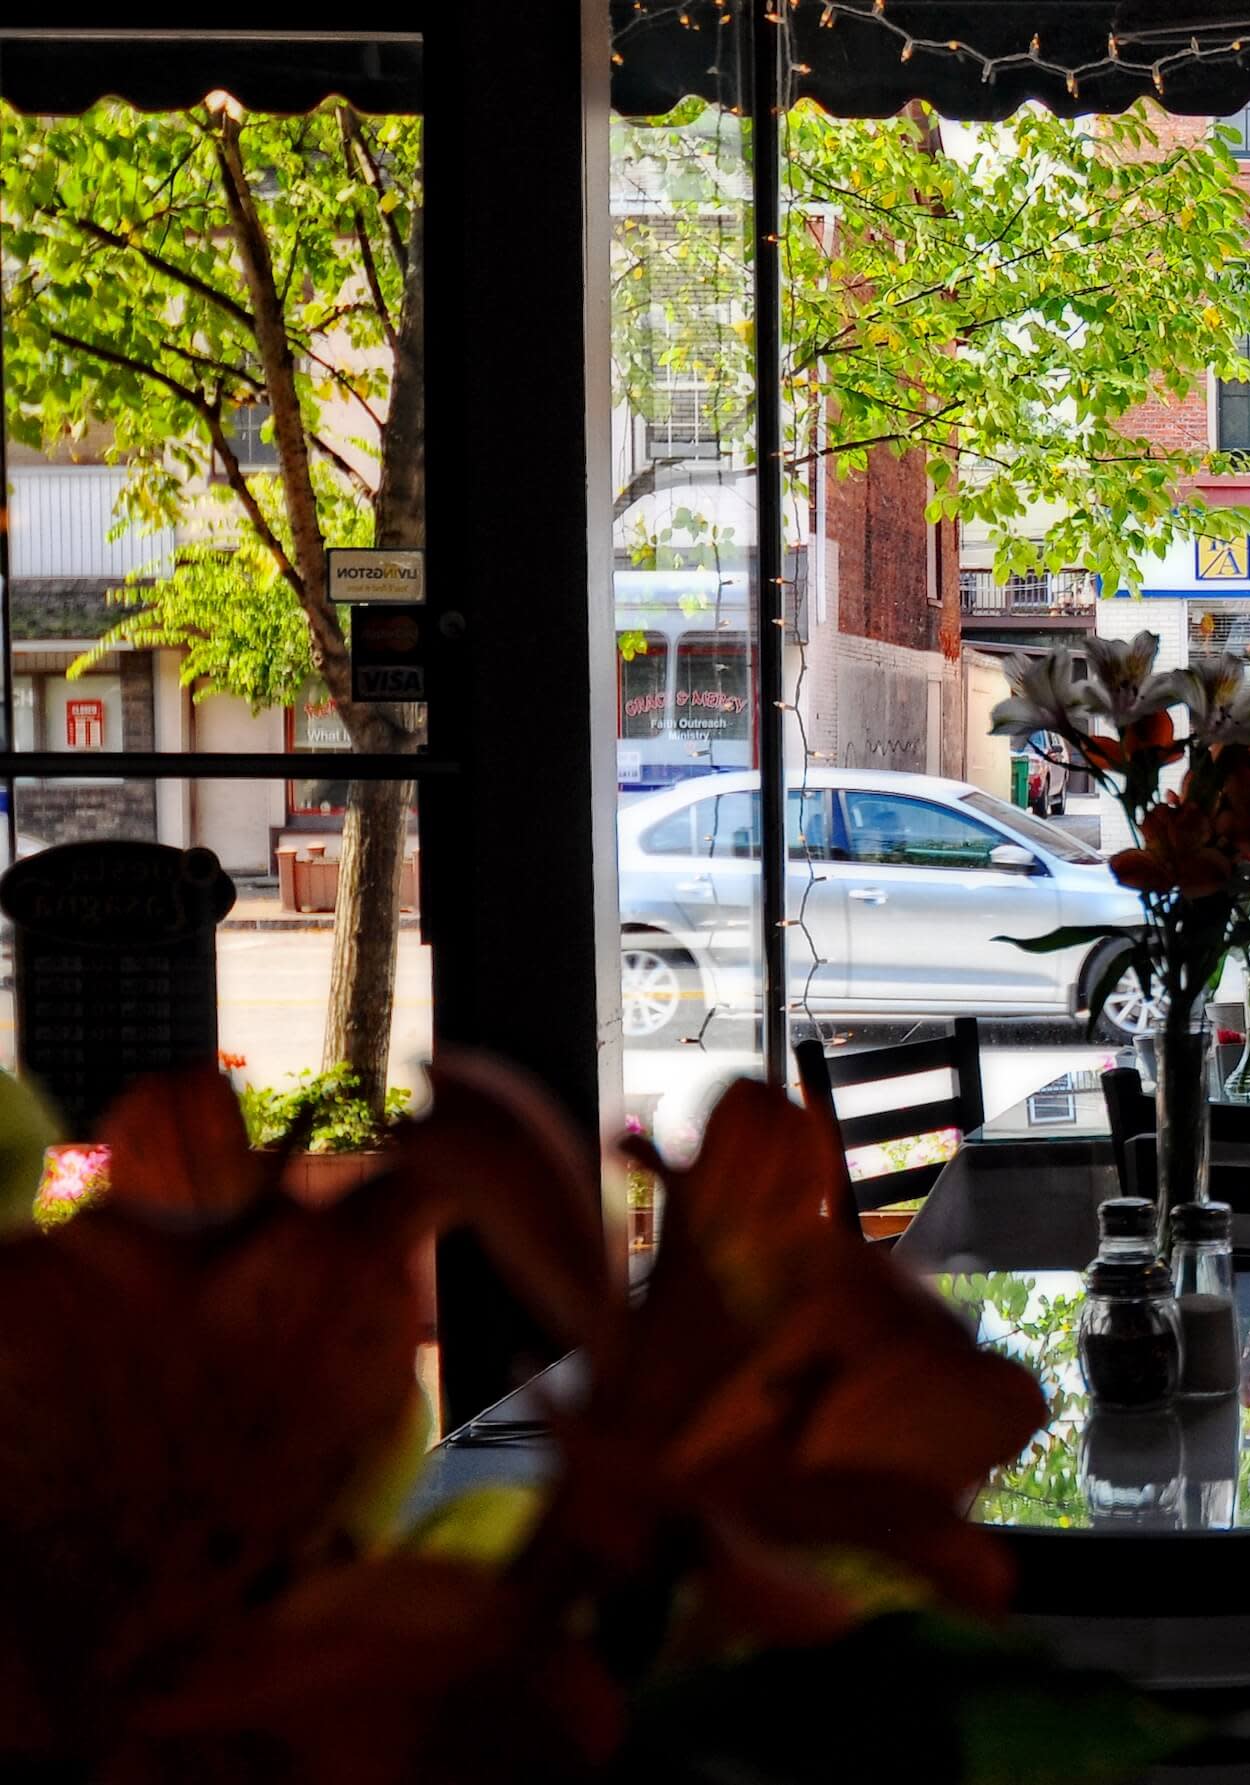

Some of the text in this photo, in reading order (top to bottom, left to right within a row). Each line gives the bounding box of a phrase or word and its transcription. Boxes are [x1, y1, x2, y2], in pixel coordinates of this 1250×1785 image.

[363, 671, 420, 690] VISA
[679, 718, 727, 729] Outreach
[308, 727, 340, 742] What
[669, 730, 711, 742] Ministry
